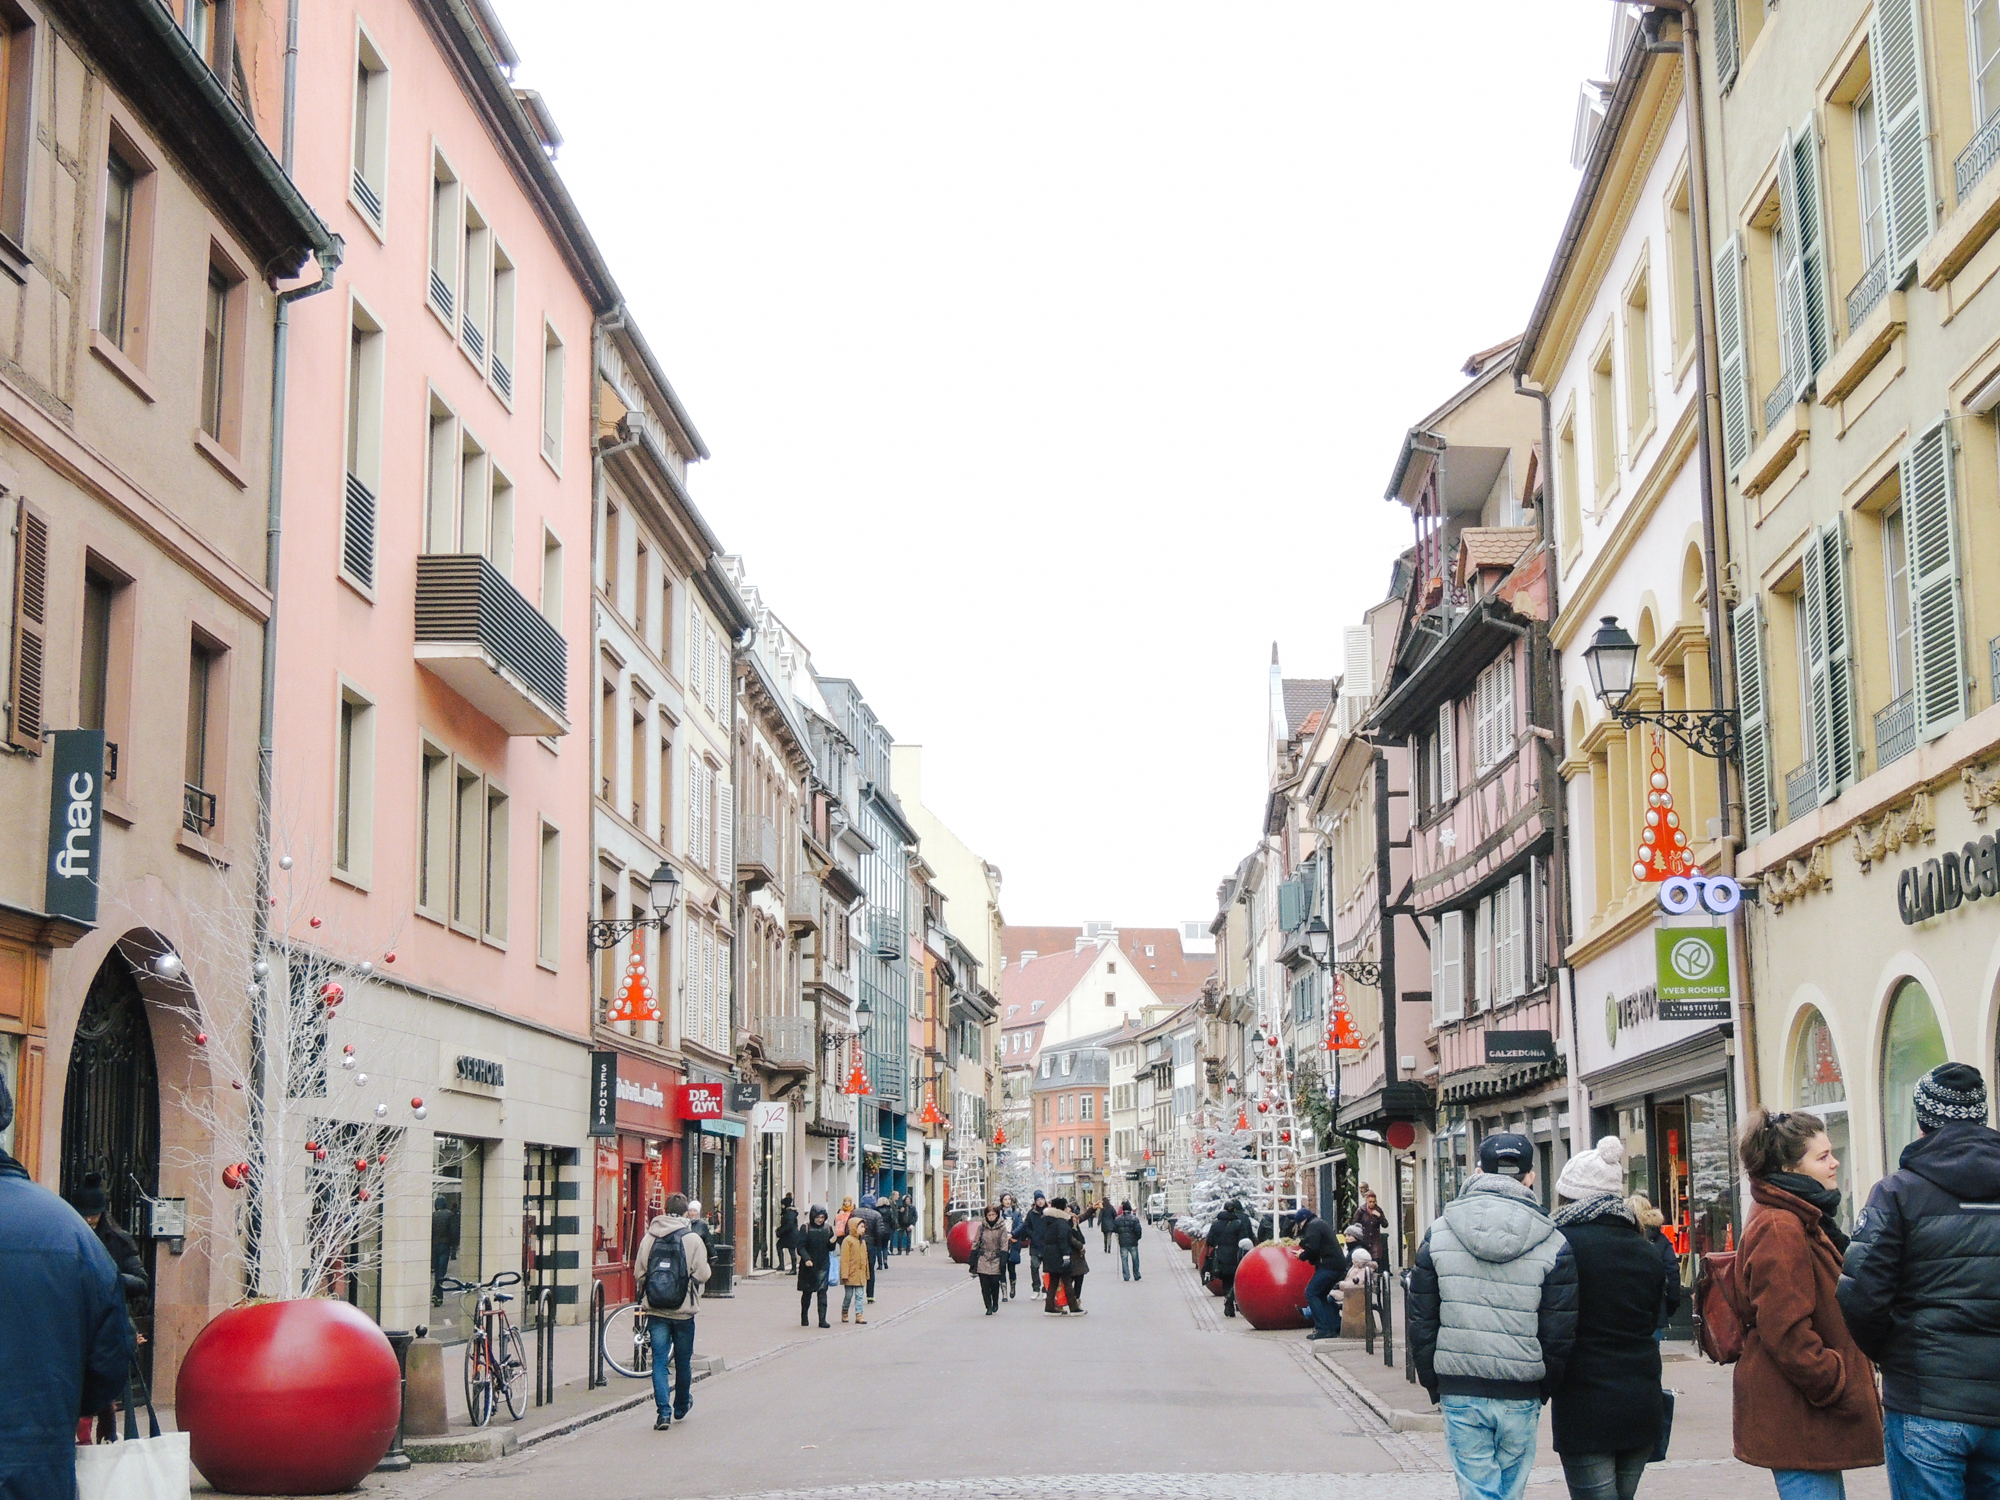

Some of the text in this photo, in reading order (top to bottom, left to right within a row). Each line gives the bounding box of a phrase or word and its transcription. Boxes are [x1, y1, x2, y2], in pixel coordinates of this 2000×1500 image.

[56, 771, 94, 879] fnac
[1662, 986, 1726, 994] YVES ROCHER
[1671, 1004, 1719, 1012] L'INSTITUT
[1488, 1049, 1546, 1057] CALZEDONIA
[456, 1054, 504, 1087] SEPHORA
[598, 1063, 608, 1125] SEPHORA
